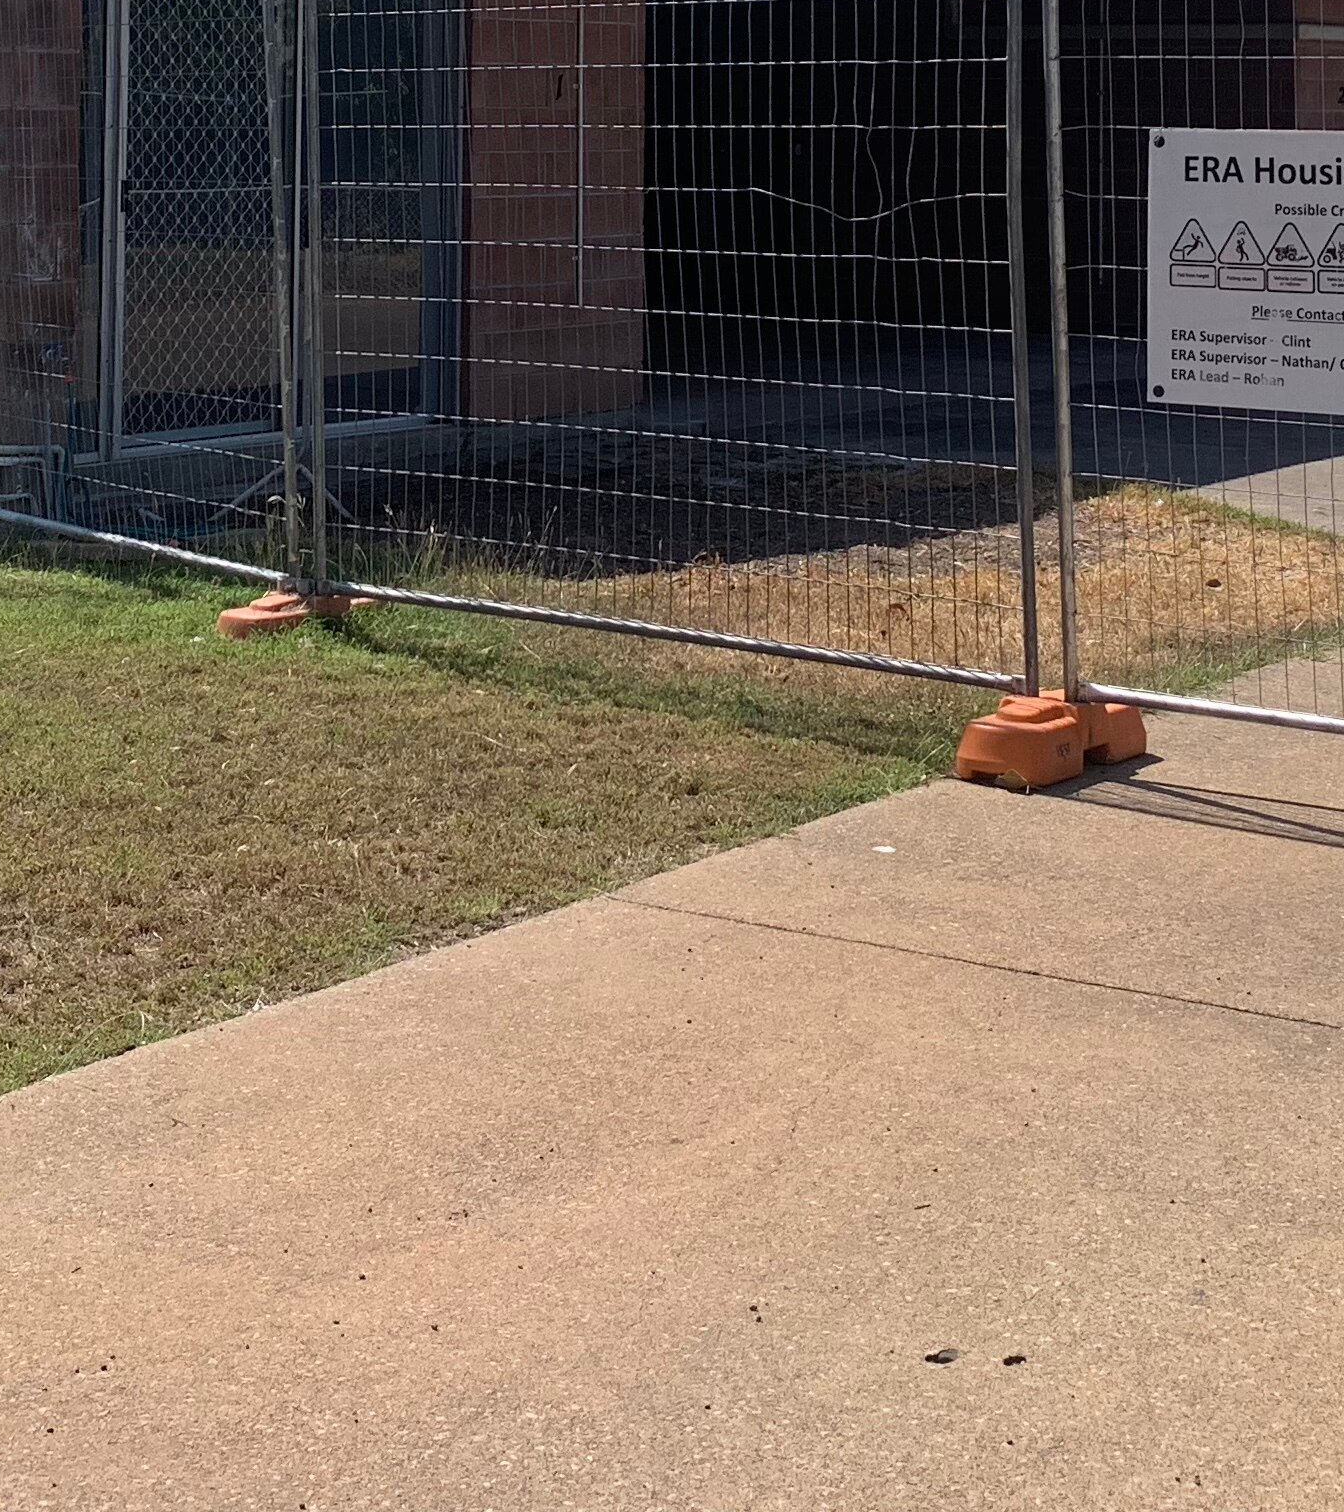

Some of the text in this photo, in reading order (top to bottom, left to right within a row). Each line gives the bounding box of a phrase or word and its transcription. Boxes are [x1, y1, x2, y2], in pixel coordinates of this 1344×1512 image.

[1184, 155, 1244, 183] ERA
[1274, 203, 1328, 217] Possible
[1251, 305, 1293, 319] Please
[1171, 329, 1196, 342] ERA
[1199, 330, 1267, 346] Supervisor
[1281, 334, 1312, 349] Clint
[1171, 349, 1196, 362] ERA
[1199, 350, 1267, 366] Supervisor
[1281, 355, 1336, 372] Nathan/
[1171, 368, 1196, 382] ERA
[1199, 370, 1229, 384] Lead
